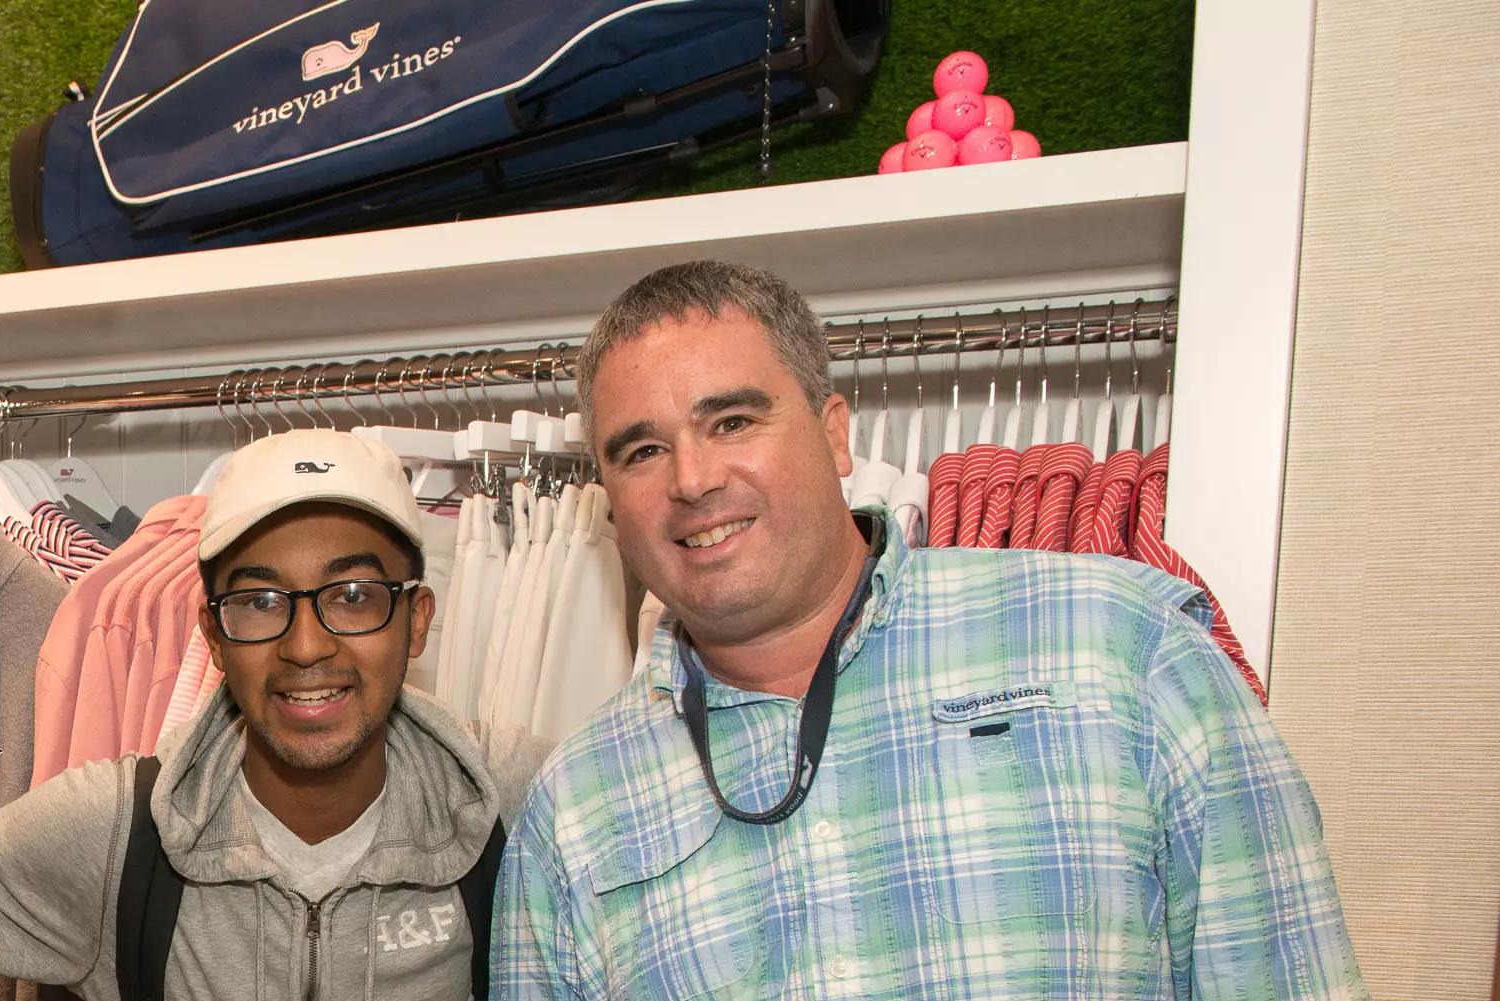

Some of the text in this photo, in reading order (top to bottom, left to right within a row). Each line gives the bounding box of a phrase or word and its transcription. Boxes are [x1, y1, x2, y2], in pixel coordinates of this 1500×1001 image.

[232, 65, 363, 134] vineyard
[943, 687, 1051, 714] vineyard vines
